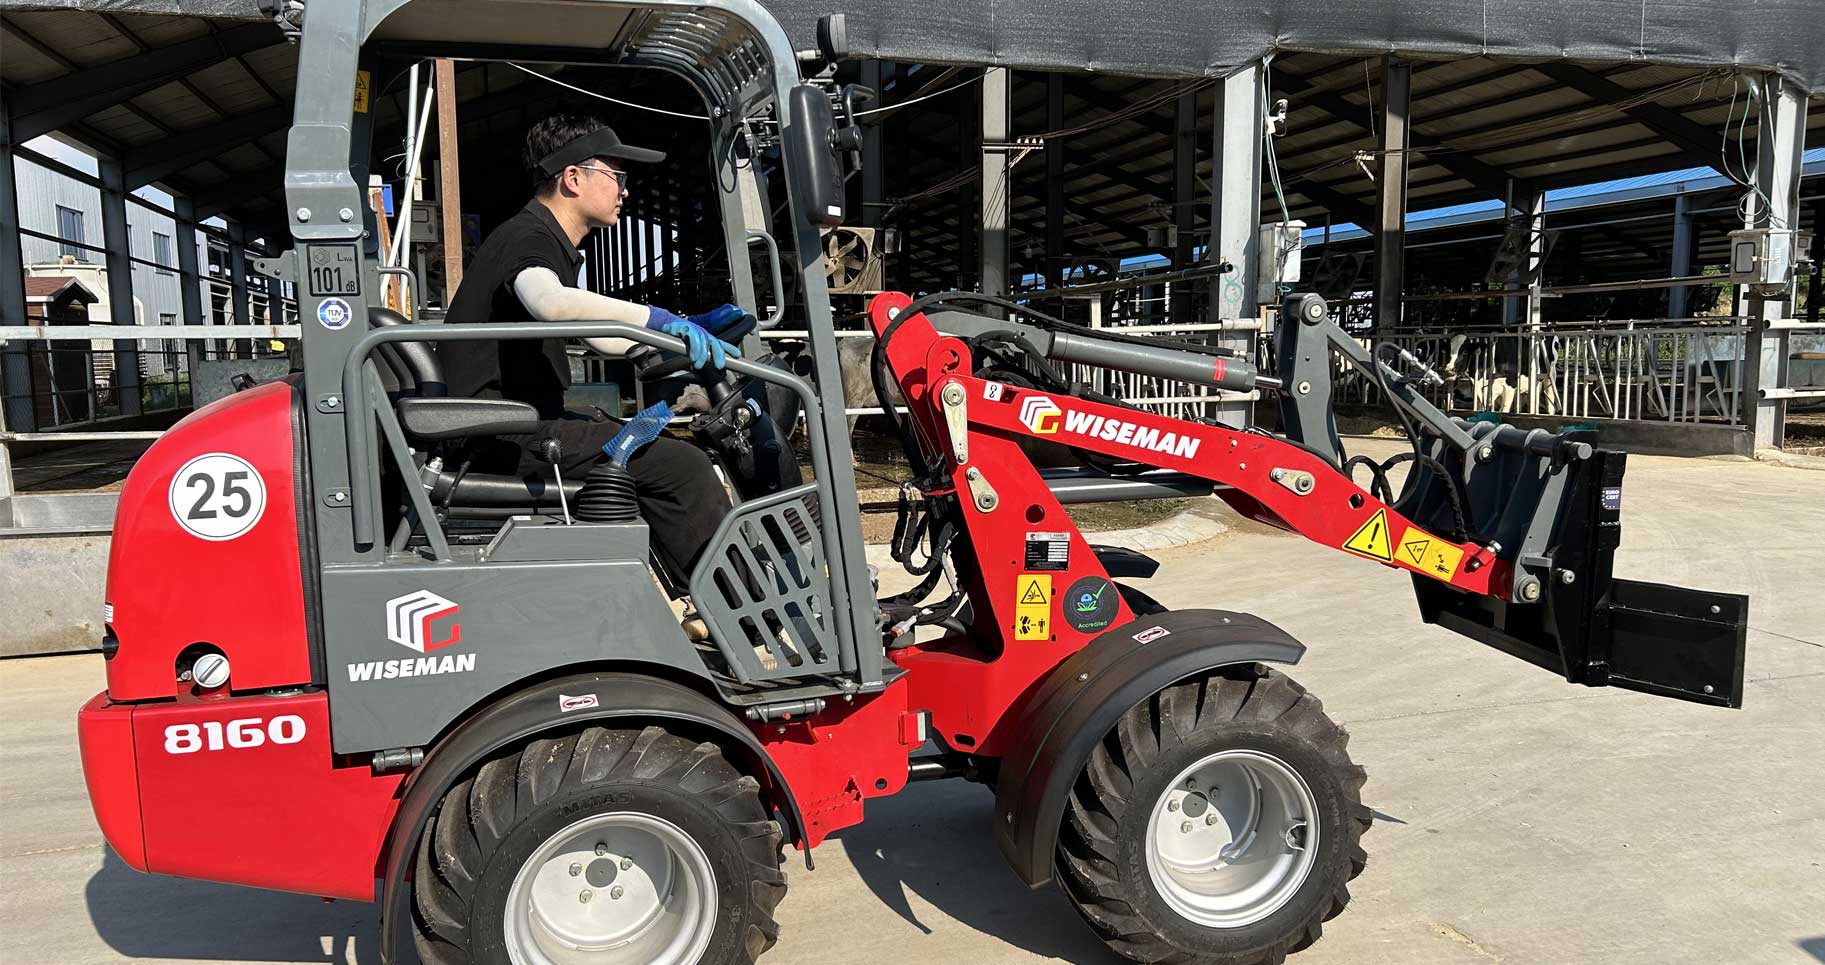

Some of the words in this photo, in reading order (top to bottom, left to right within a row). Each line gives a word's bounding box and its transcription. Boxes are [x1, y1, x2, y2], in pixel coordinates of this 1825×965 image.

[313, 267, 342, 292] 101
[346, 280, 355, 292] dB
[1064, 409, 1201, 459] WISEMAN
[186, 471, 251, 520] 25
[1078, 620, 1107, 629] Accredited
[347, 653, 476, 682] WISEMAN
[164, 714, 306, 755] 8160
